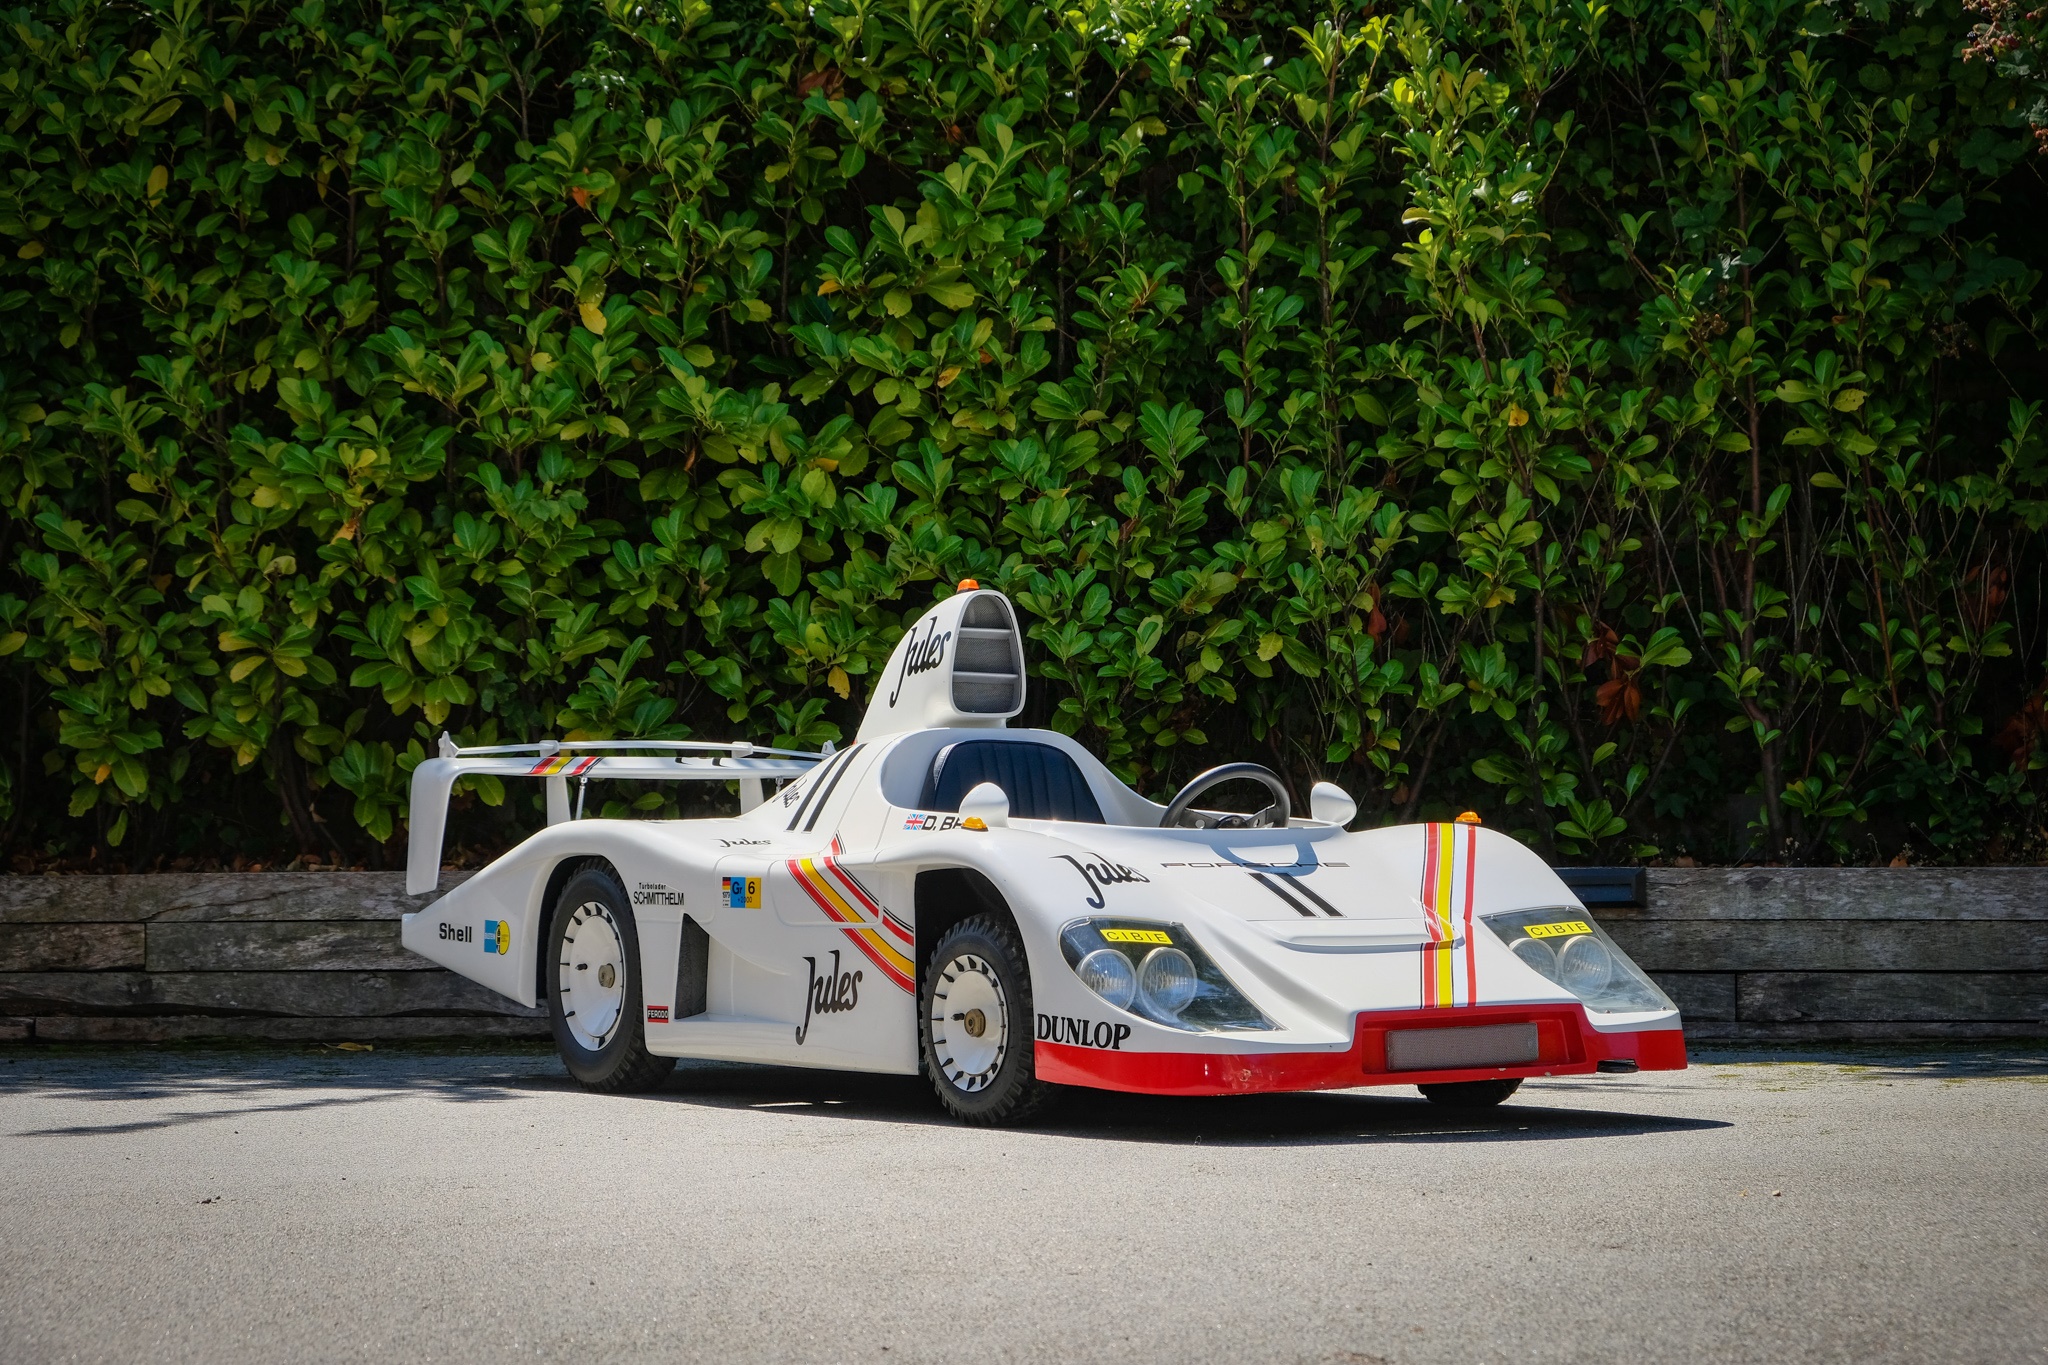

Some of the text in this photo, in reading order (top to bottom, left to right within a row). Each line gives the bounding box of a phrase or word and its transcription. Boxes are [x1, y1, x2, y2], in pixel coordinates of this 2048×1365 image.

[889, 615, 952, 709] Jules
[711, 838, 771, 848] Jules
[638, 882, 667, 890] Turbolader
[1048, 851, 1151, 910] Jules
[732, 881, 755, 895] Gr 6
[633, 891, 685, 905] SCHMITTHELM
[439, 922, 472, 943] Shell
[1530, 922, 1589, 936] CIBIE
[1106, 931, 1168, 943] CIBIE
[795, 949, 863, 1046] Jules
[1036, 1013, 1131, 1050] DUNLOP
